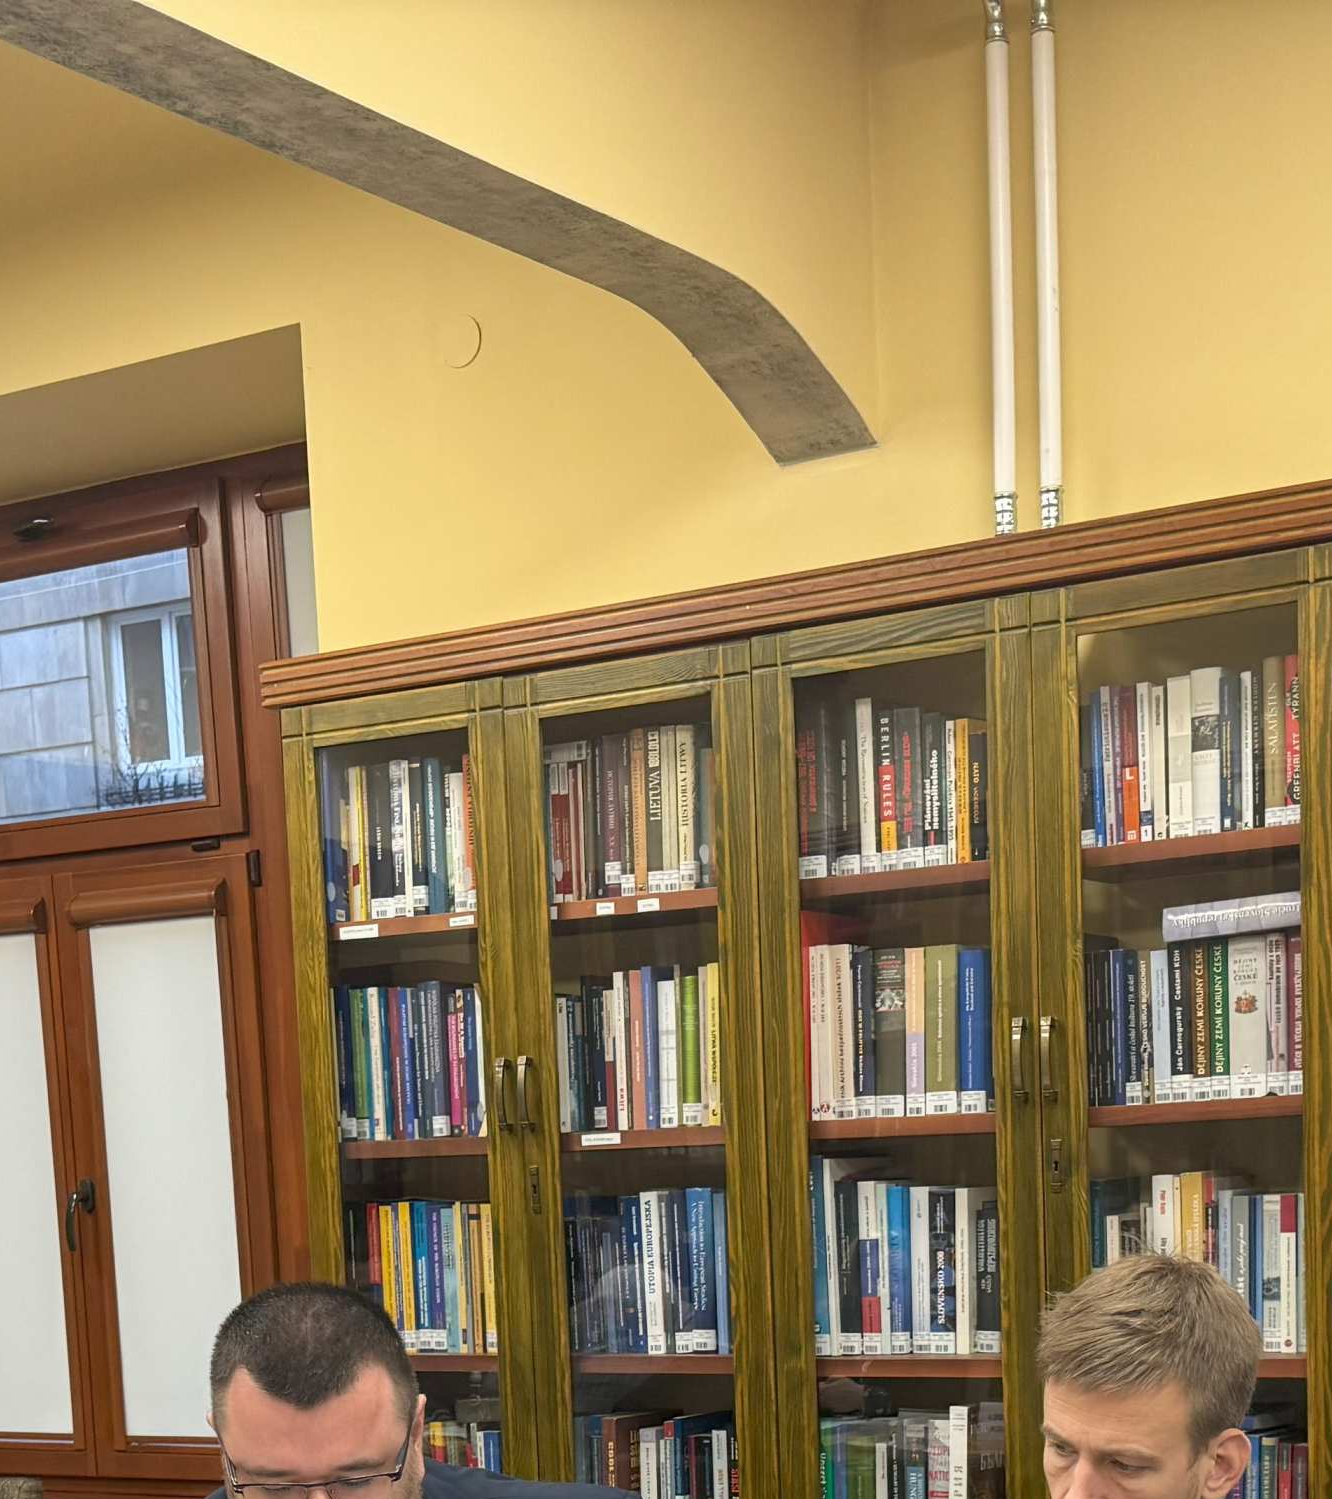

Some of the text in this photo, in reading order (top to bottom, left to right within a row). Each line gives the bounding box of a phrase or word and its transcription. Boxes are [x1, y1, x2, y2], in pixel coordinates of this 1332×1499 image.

[649, 770, 662, 821] LIETUVA
[879, 717, 892, 817] BERLIN RULES
[643, 1199, 657, 1295] UTOPIA EUROPEJSKA
[937, 1271, 947, 1325] SLOVENSKO
